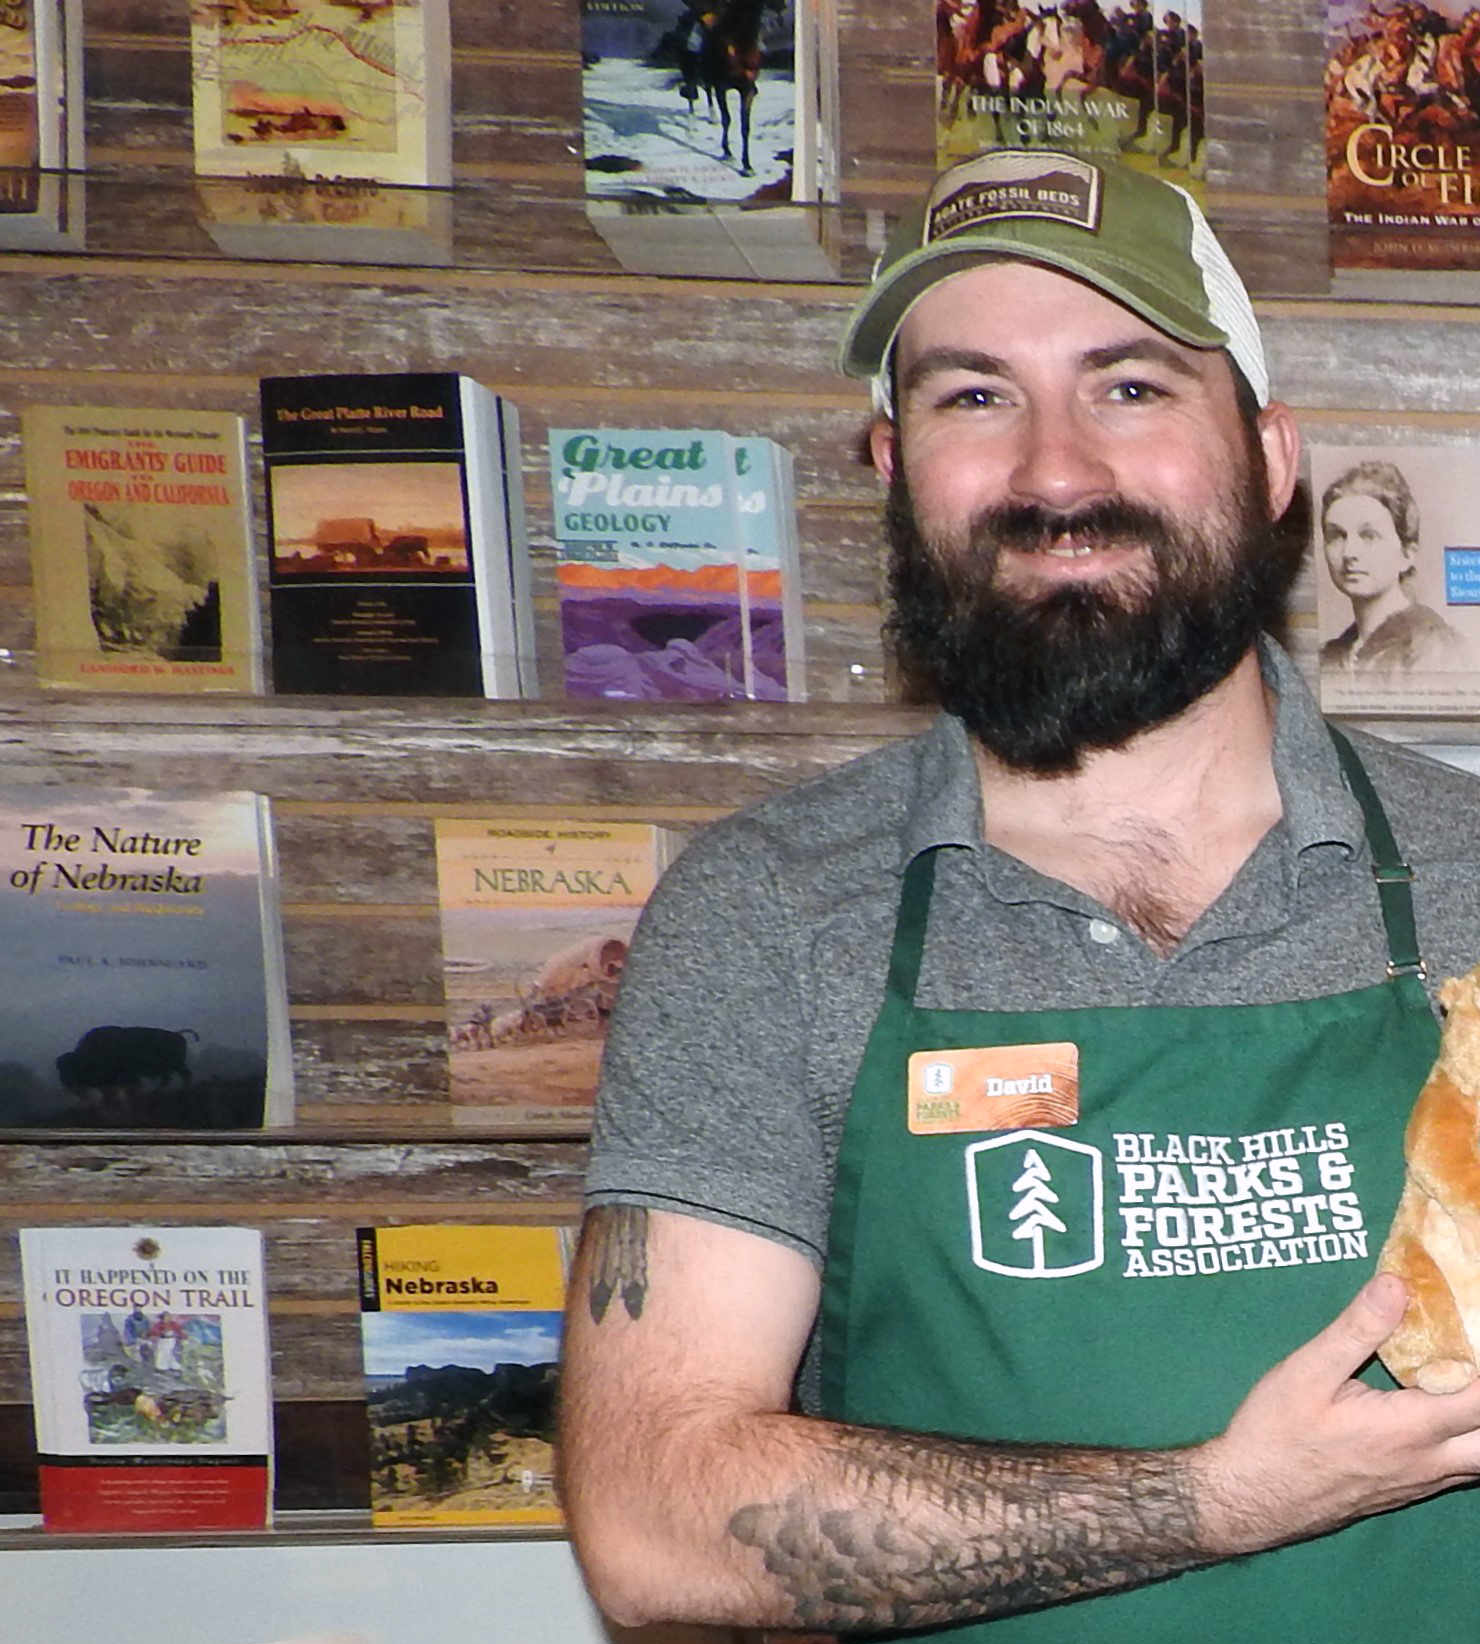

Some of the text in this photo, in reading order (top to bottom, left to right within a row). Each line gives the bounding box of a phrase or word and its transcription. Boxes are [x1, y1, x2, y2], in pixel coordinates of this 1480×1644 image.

[971, 95, 1130, 120] THE INDIAN WAR
[1016, 122, 1042, 139] OF
[978, 187, 1080, 207] FOSSIL BEDS
[1343, 212, 1374, 225] THE
[1378, 212, 1431, 226] INDIAN
[1434, 214, 1469, 227] WAR
[276, 408, 299, 421] The
[300, 407, 335, 421] Great
[373, 405, 408, 419] River
[409, 405, 445, 419] Road
[173, 453, 228, 475] GUIDE
[561, 434, 708, 474] Great
[66, 480, 121, 502] OREGON
[125, 483, 151, 503] AND
[557, 470, 724, 507] Plains
[563, 512, 673, 533] GEOLOGY
[21, 822, 203, 857] The Nature
[9, 860, 203, 896] of Nebraska
[474, 867, 633, 896] NEBRASKA
[985, 1073, 1054, 1099] David
[1112, 1121, 1351, 1167] BLACK HILLS
[1115, 1150, 1357, 1205] PARKS &
[1119, 1192, 1365, 1249] FORESTS
[1122, 1229, 1370, 1279] ASSOCIATION
[54, 1269, 252, 1287] IT HAPPENED ON THE
[383, 1260, 441, 1274] HIKING
[54, 1287, 255, 1309] OREGON TRAIL
[386, 1276, 499, 1296] Nebraska
